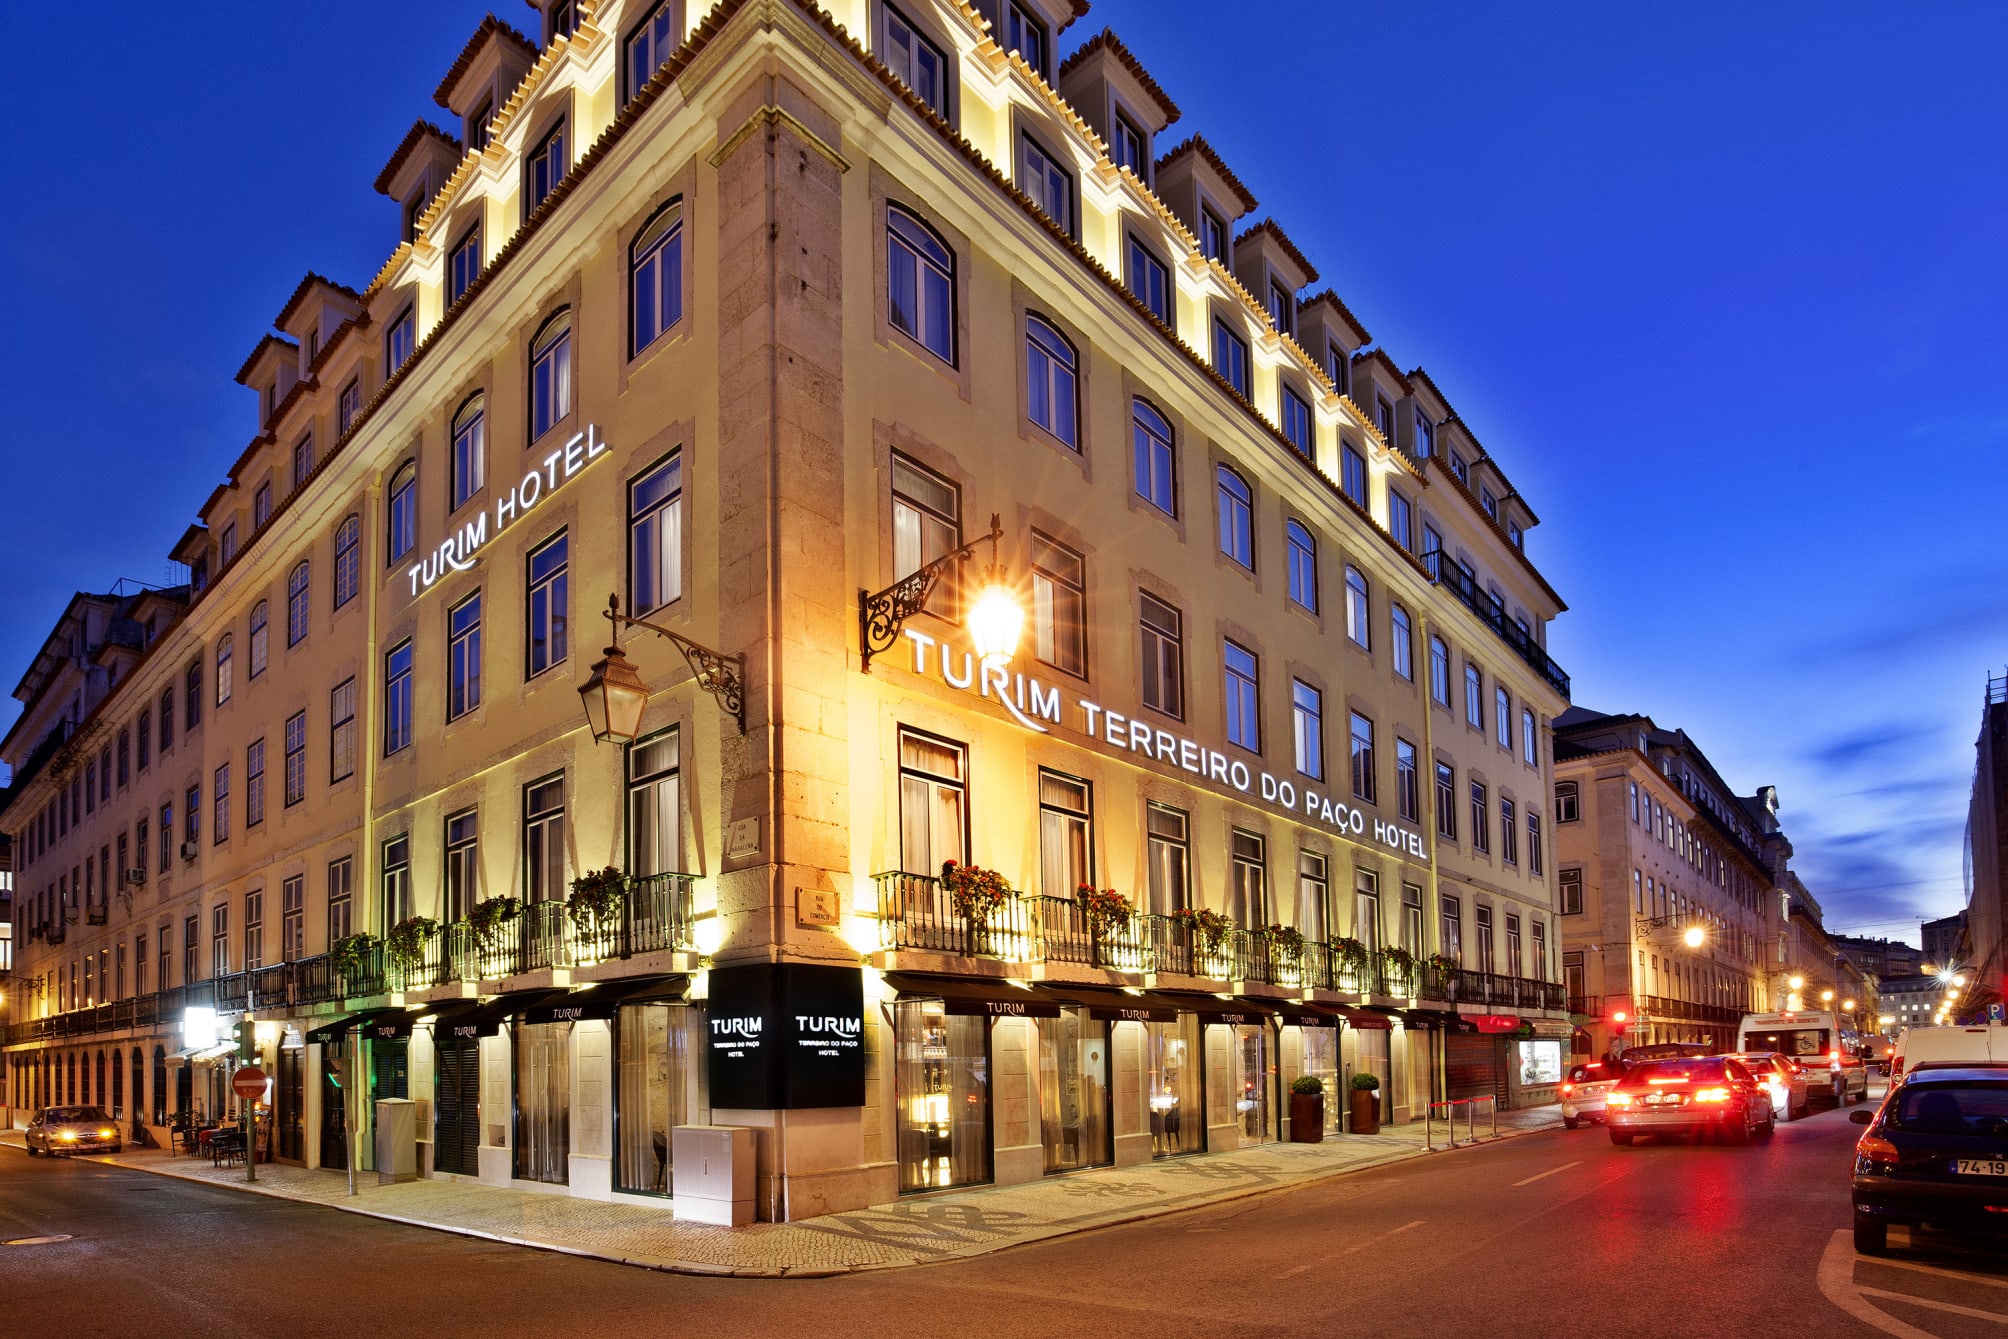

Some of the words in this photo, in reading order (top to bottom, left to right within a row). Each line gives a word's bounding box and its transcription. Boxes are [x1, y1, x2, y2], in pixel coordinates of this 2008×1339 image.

[408, 511, 486, 597] TURIM
[497, 423, 606, 529] HOTEL
[903, 628, 1061, 733] TURIM
[1079, 699, 1250, 791] TERREIRO
[1261, 771, 1295, 809] DO
[1306, 790, 1364, 834] PAÇO
[1373, 817, 1427, 860] HOTEL
[553, 1008, 582, 1021] TURIM
[987, 1002, 1025, 1017] TURIM
[1120, 1008, 1149, 1022] TURIM
[1991, 1004, 2000, 1017] P
[1221, 1013, 1245, 1024] TURIM
[1300, 1016, 1319, 1027] TURIM
[378, 1026, 396, 1038] TURIM
[454, 1025, 477, 1038] TURIM
[711, 1016, 762, 1038] TURIM
[795, 1016, 861, 1038] TURIM
[317, 1032, 332, 1044] TURIM
[745, 1040, 760, 1048] PAÇO
[841, 1040, 858, 1048] PAÇO
